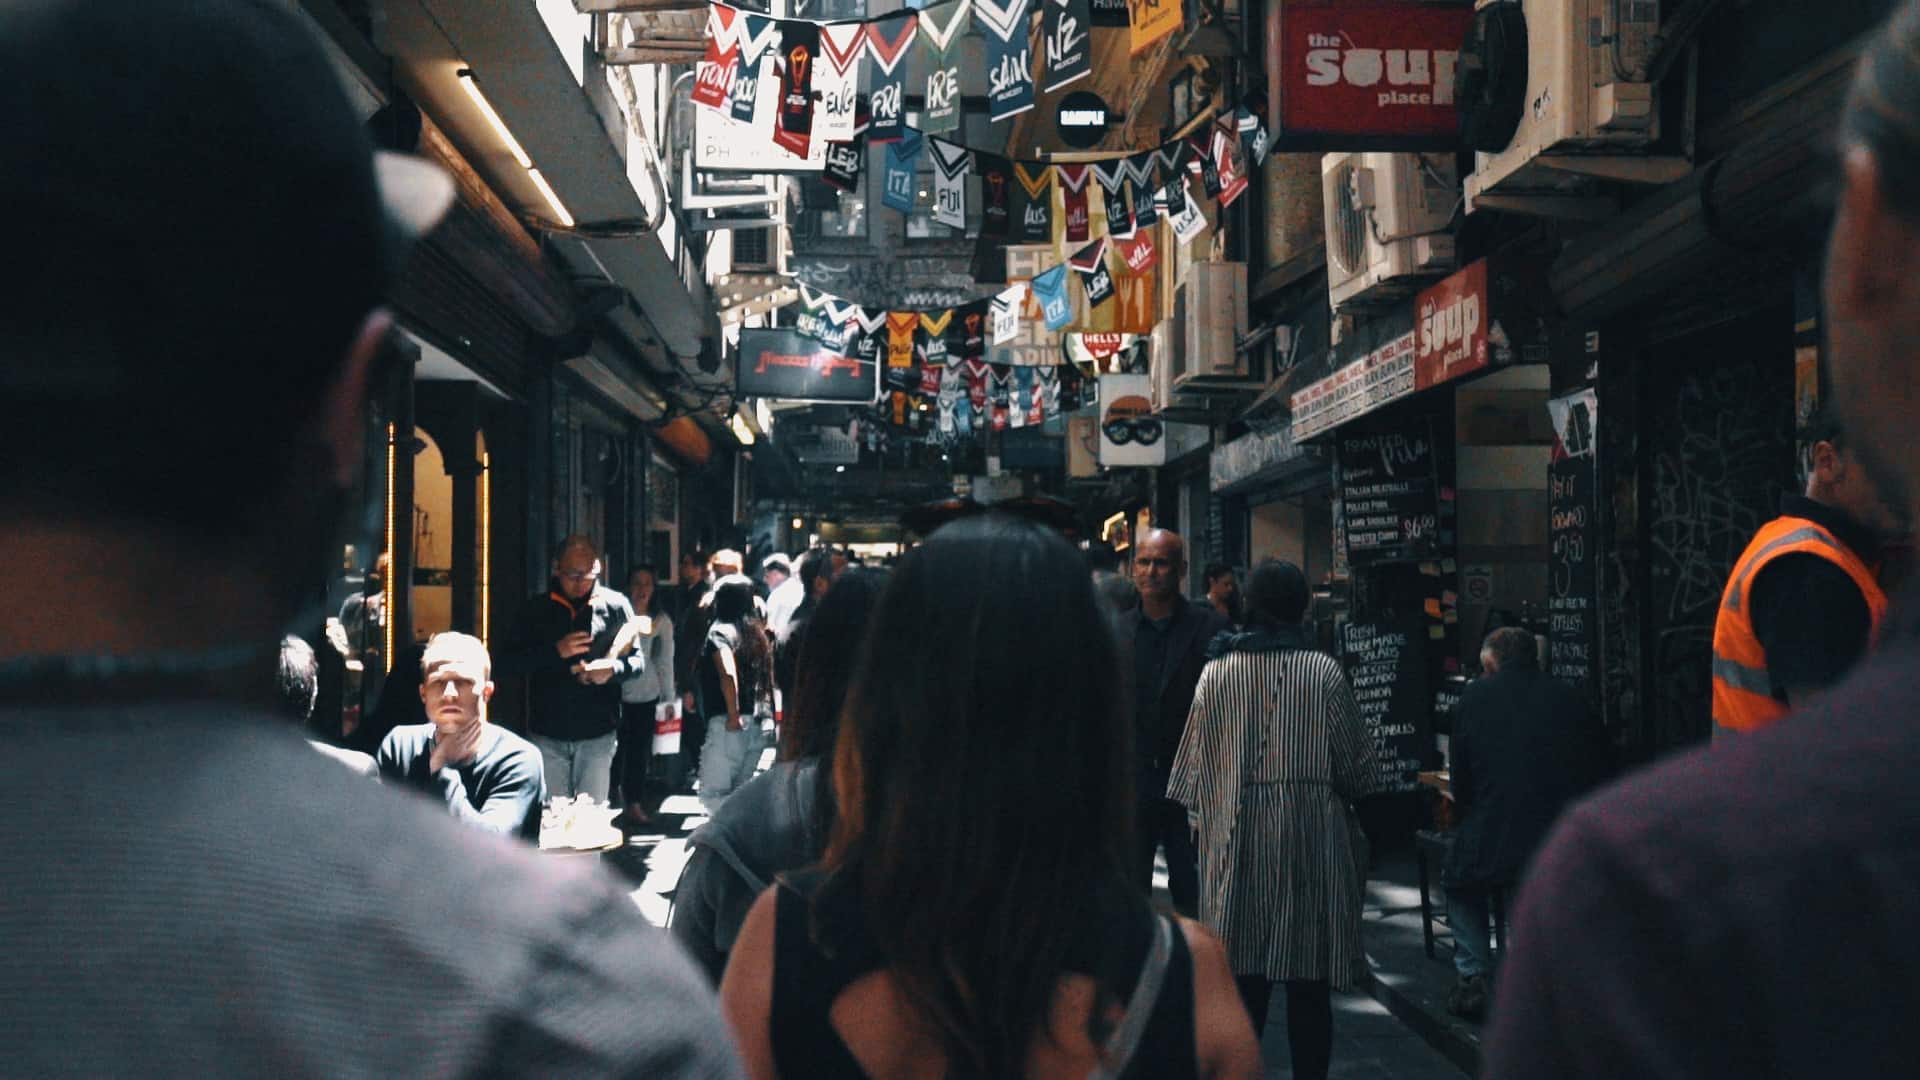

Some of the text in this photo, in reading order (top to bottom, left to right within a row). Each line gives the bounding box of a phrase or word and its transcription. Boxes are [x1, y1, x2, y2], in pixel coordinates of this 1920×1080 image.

[1047, 12, 1087, 67] NZ
[1308, 33, 1341, 48] the
[871, 81, 901, 118] FRA
[926, 66, 958, 110] IRE
[1377, 92, 1430, 107] place
[939, 187, 960, 211] FIJI
[1174, 203, 1198, 235] USA
[1420, 292, 1480, 358] soup
[926, 338, 946, 354] AUS
[1344, 622, 1376, 640] FRESH
[1372, 633, 1406, 649] MADE
